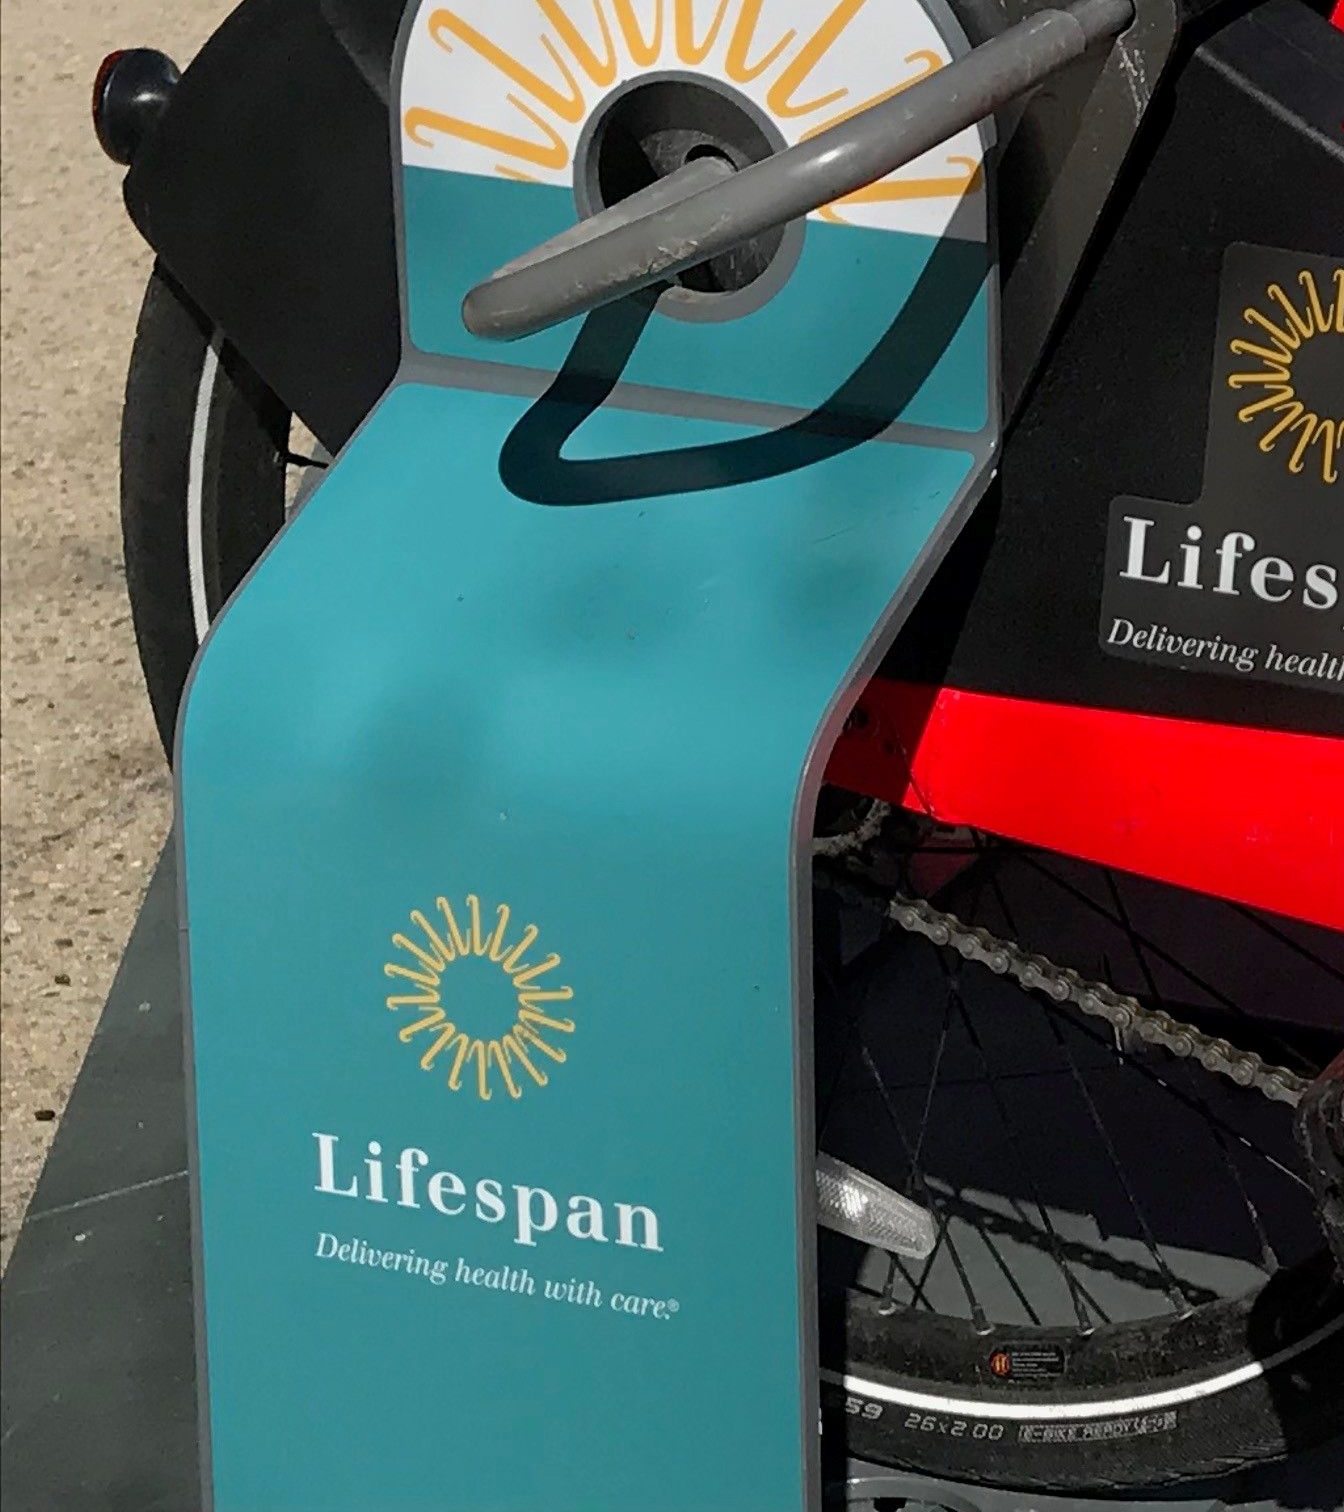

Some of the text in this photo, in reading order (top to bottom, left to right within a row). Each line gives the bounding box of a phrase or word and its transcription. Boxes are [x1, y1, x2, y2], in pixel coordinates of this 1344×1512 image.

[1106, 618, 1259, 671] Delivering
[311, 1131, 664, 1253] Lifespan
[314, 1231, 449, 1286] Delivering
[454, 1257, 536, 1296] health
[544, 1278, 603, 1310] with
